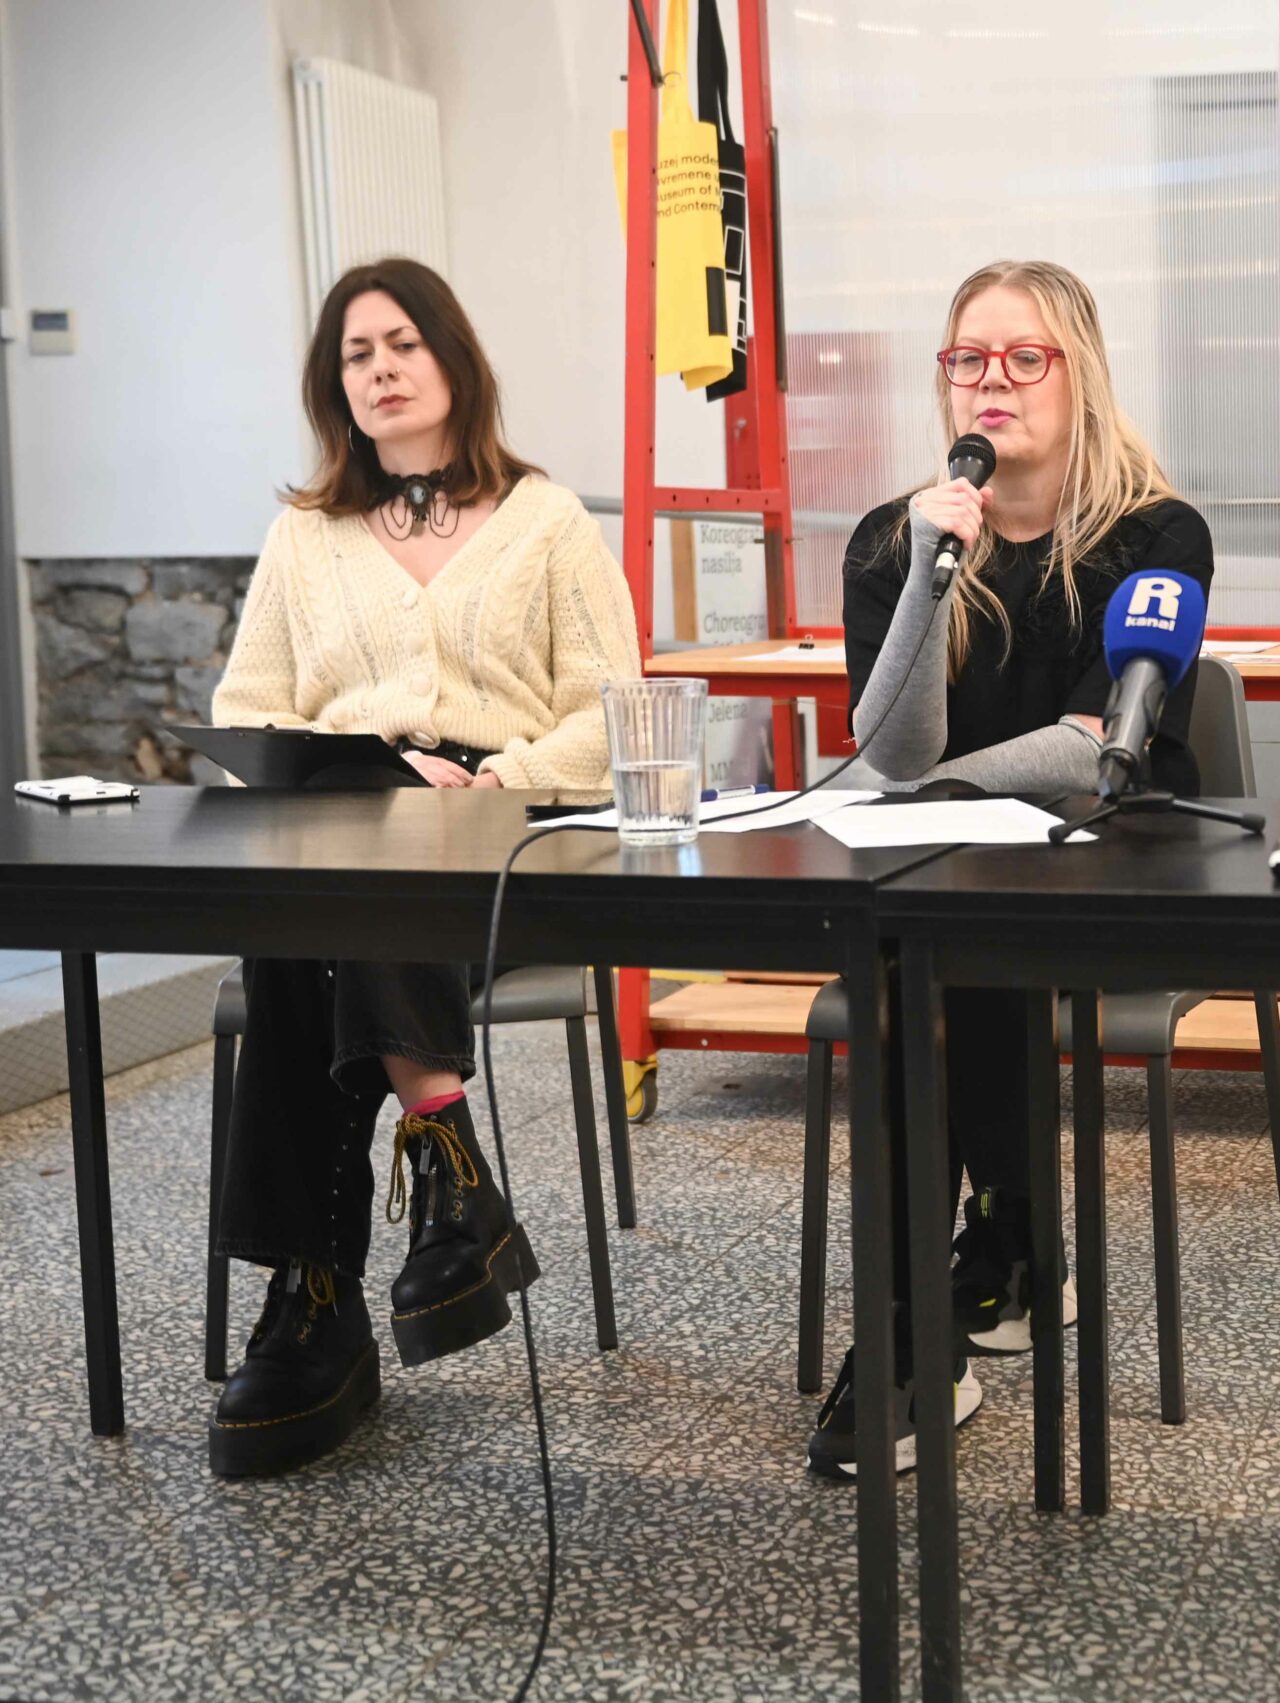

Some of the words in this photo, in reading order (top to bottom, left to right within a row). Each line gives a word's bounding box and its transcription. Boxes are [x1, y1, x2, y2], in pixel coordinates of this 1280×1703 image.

[699, 184, 712, 195] of
[701, 551, 742, 577] nasilja
[1127, 577, 1183, 620] R
[1125, 615, 1176, 632] kanal
[708, 699, 749, 723] Jelena
